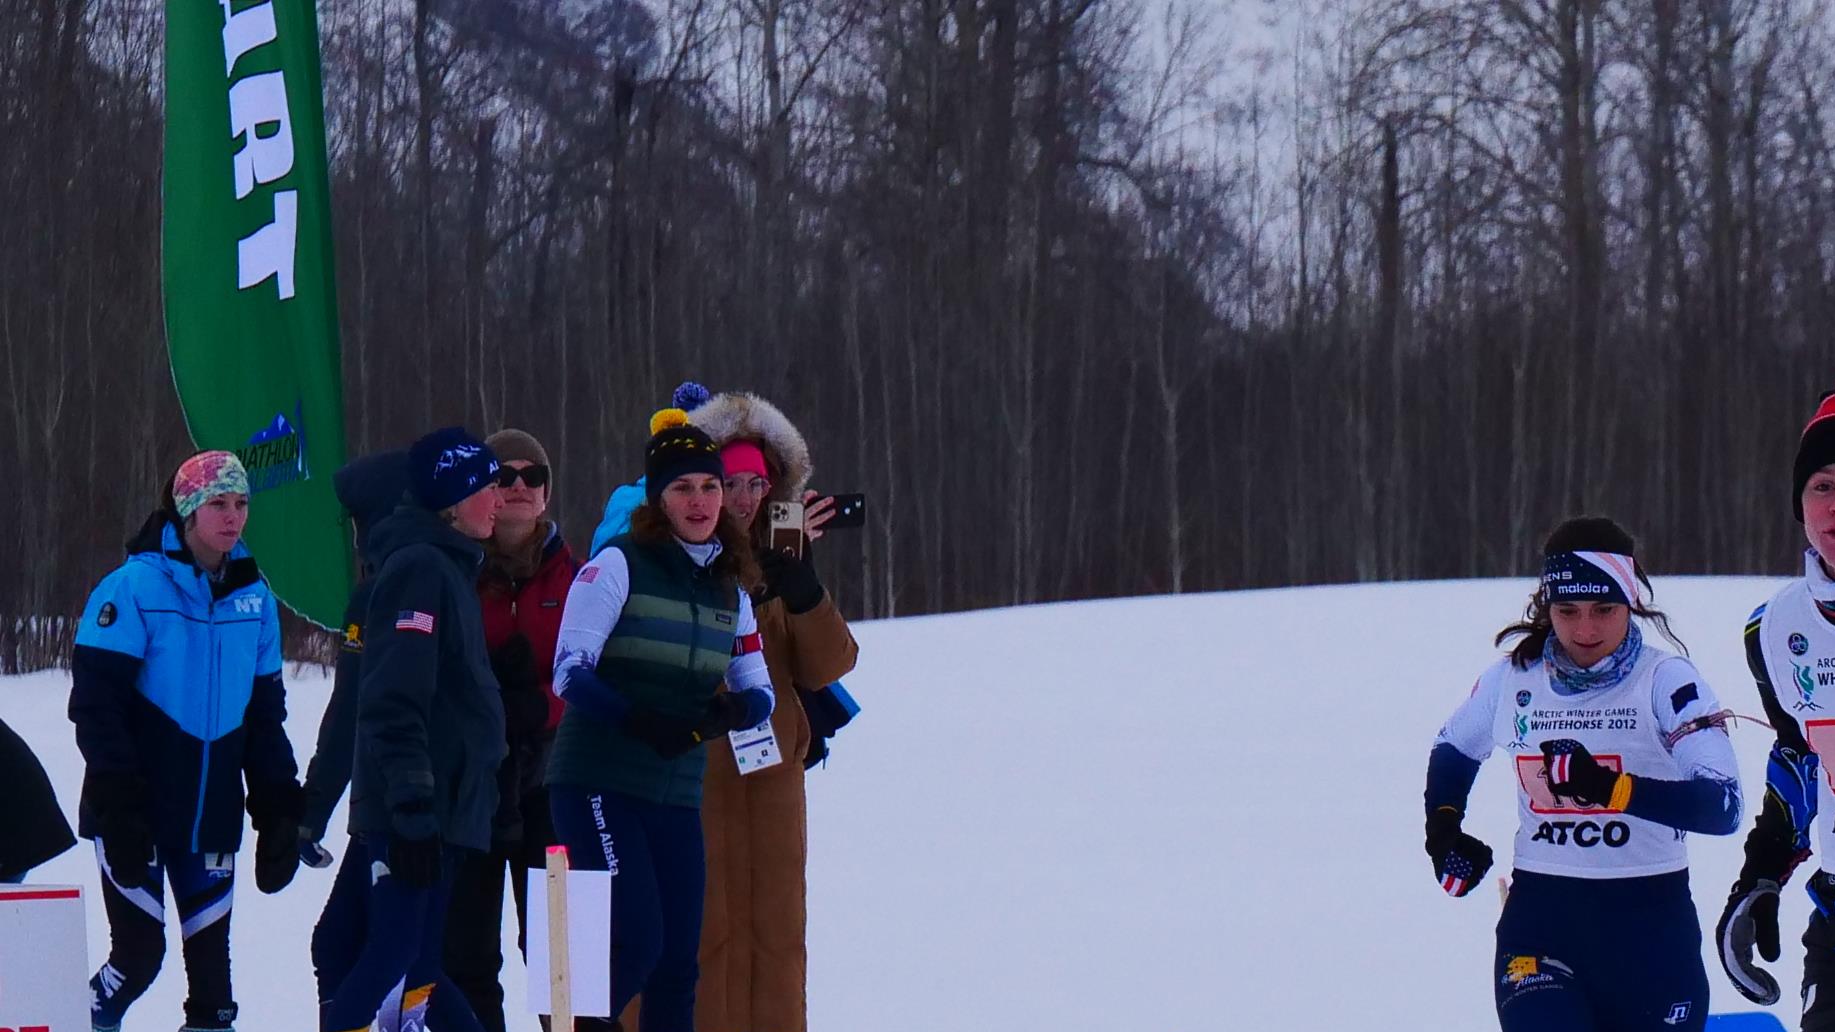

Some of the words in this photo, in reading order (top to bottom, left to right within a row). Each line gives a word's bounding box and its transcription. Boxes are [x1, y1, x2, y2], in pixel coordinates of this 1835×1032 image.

[234, 597, 262, 614] NT
[1531, 709, 1563, 719] ARCTIC
[1566, 709, 1602, 719] WINTER
[1604, 707, 1638, 717] GAMES
[1530, 719, 1604, 731] WHITEHORSE
[1607, 719, 1637, 730] 2012
[589, 794, 607, 831] Team
[599, 831, 620, 877] Alaska
[1531, 820, 1631, 848] ATCO
